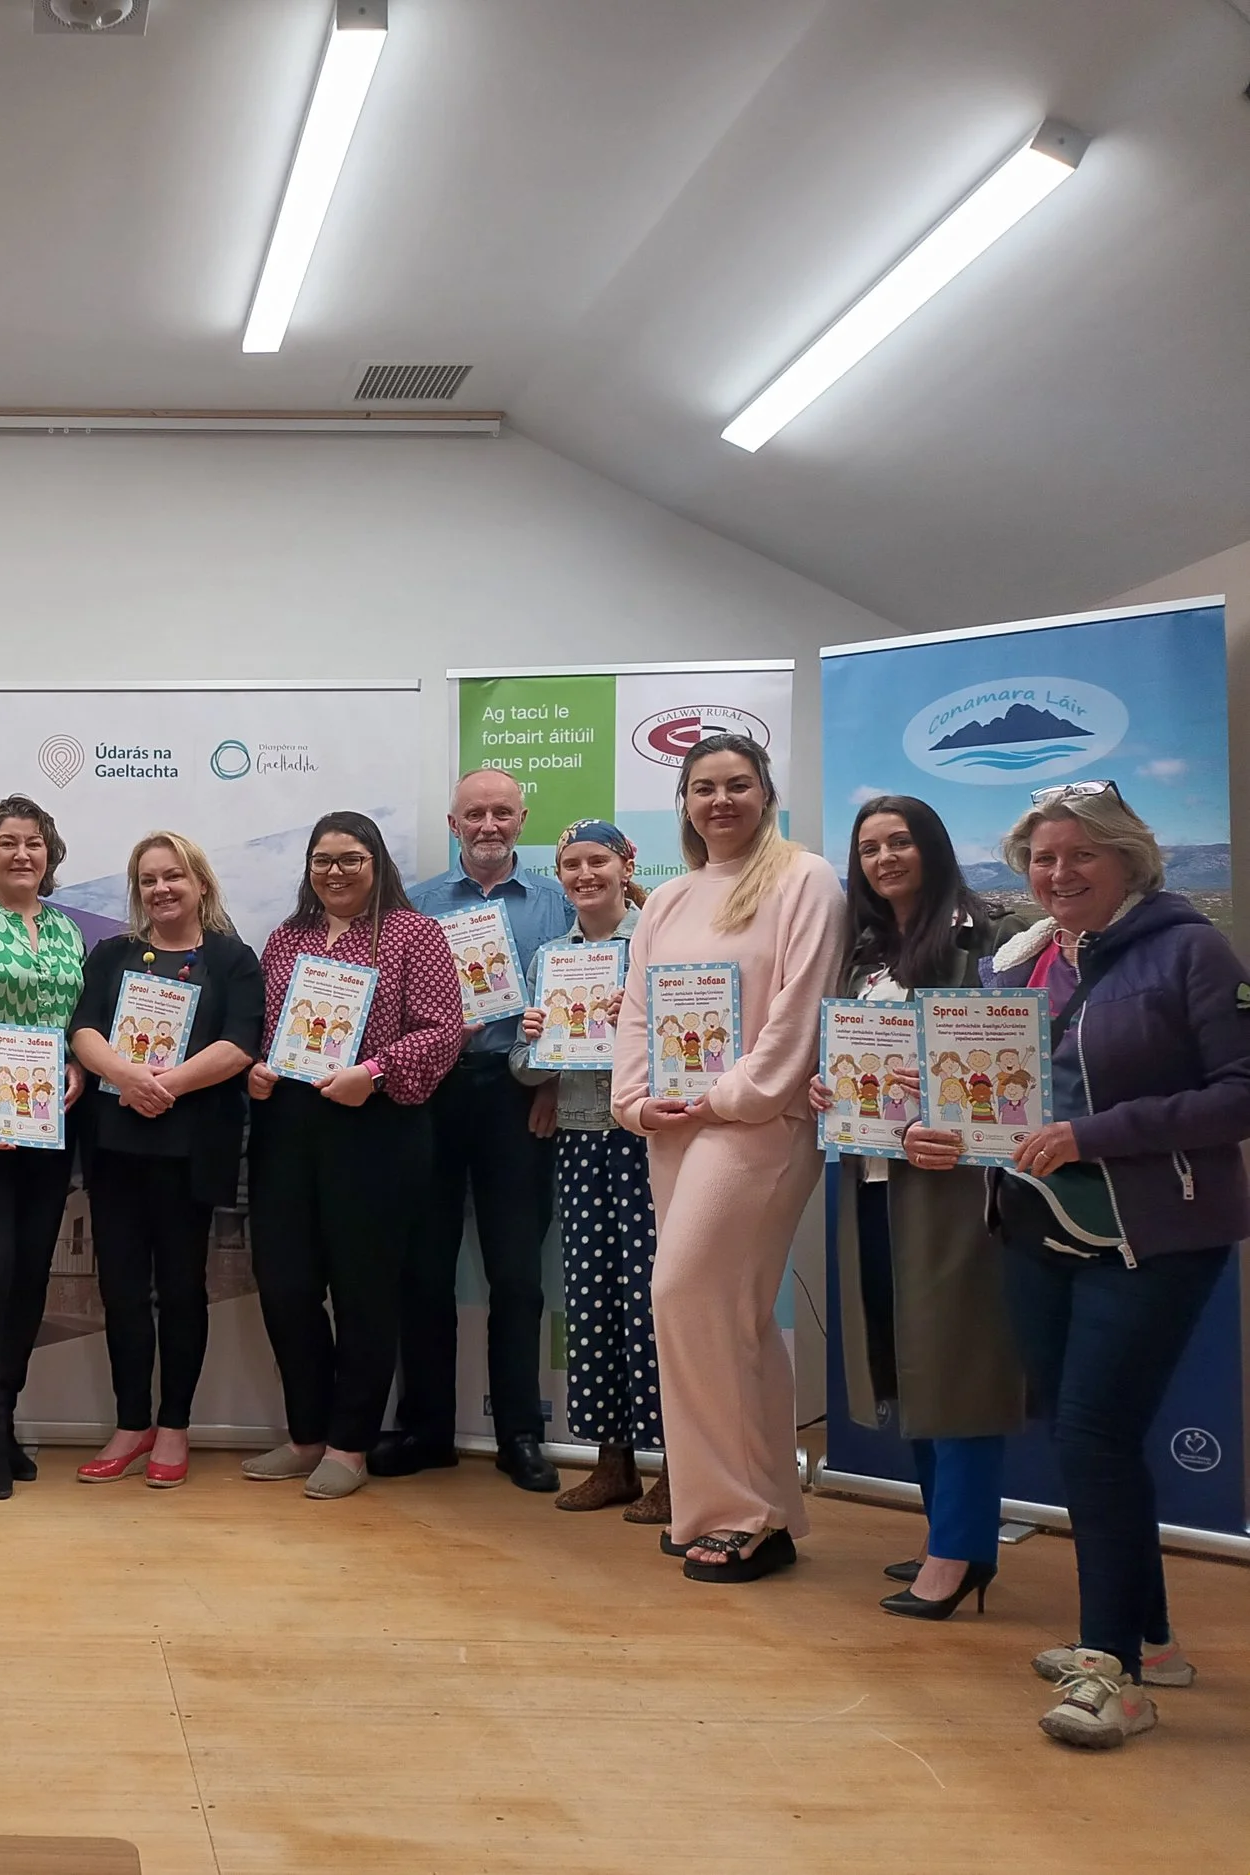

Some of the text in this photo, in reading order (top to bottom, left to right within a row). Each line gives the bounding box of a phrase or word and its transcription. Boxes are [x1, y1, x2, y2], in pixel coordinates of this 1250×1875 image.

[482, 703, 570, 724] Ag tacú le
[657, 708, 745, 724] GALWAY RURAL
[928, 689, 1087, 735] Conamara Láir
[482, 727, 594, 746] forbairt áitiúil
[95, 742, 172, 759] Údarás na
[95, 763, 178, 778] Gaeltachta
[528, 753, 582, 772] pobail
[658, 977, 684, 989] Spraoi
[696, 975, 726, 986] Забава
[834, 1013, 864, 1026] Spraoi
[879, 1015, 914, 1027] Забава
[932, 1005, 968, 1019] Spraoi
[986, 1005, 1029, 1017] Забава
